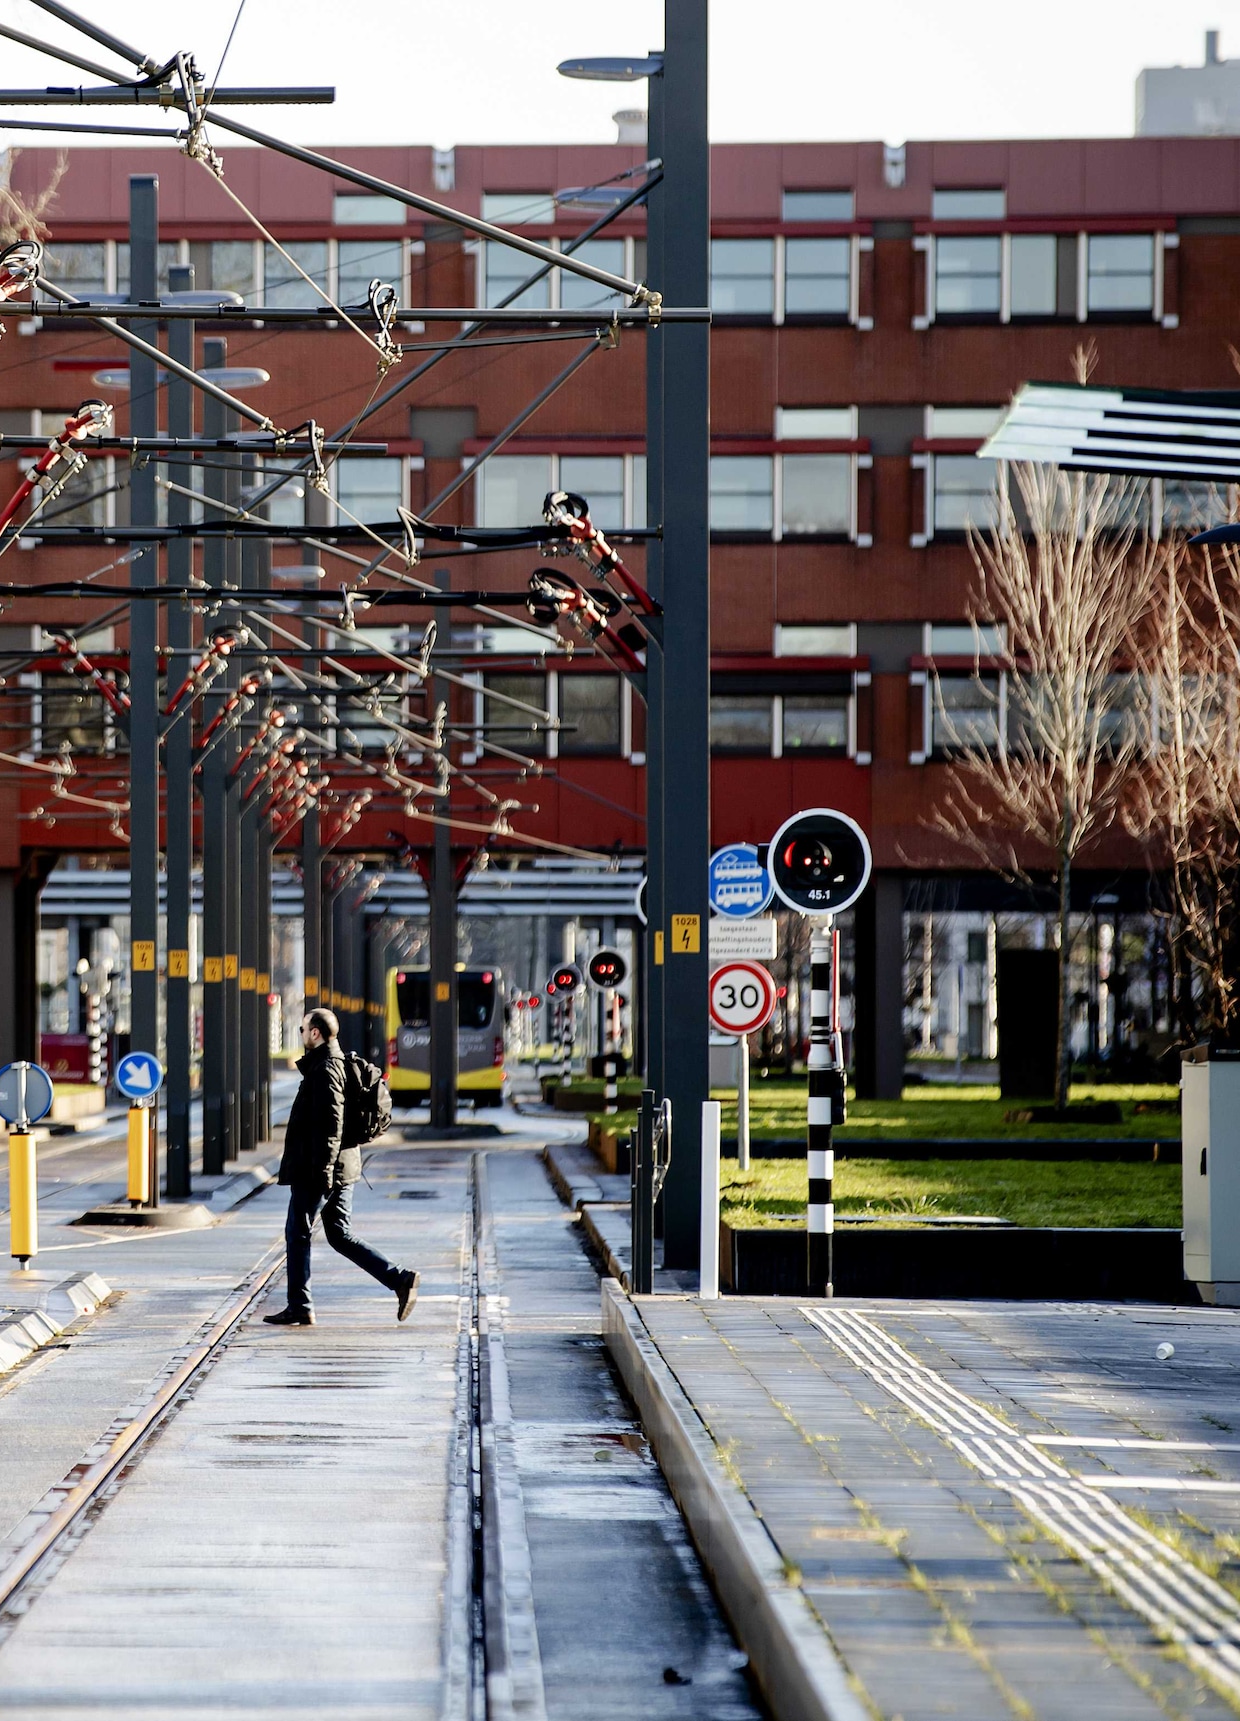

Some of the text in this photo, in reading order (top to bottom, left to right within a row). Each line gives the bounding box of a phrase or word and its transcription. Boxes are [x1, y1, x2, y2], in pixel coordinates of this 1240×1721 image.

[807, 889, 831, 901] 45.1
[675, 917, 698, 926] 1028
[709, 935, 772, 944] ntheffingshouders
[710, 946, 751, 955] itgezonderd
[719, 985, 759, 1009] 30
